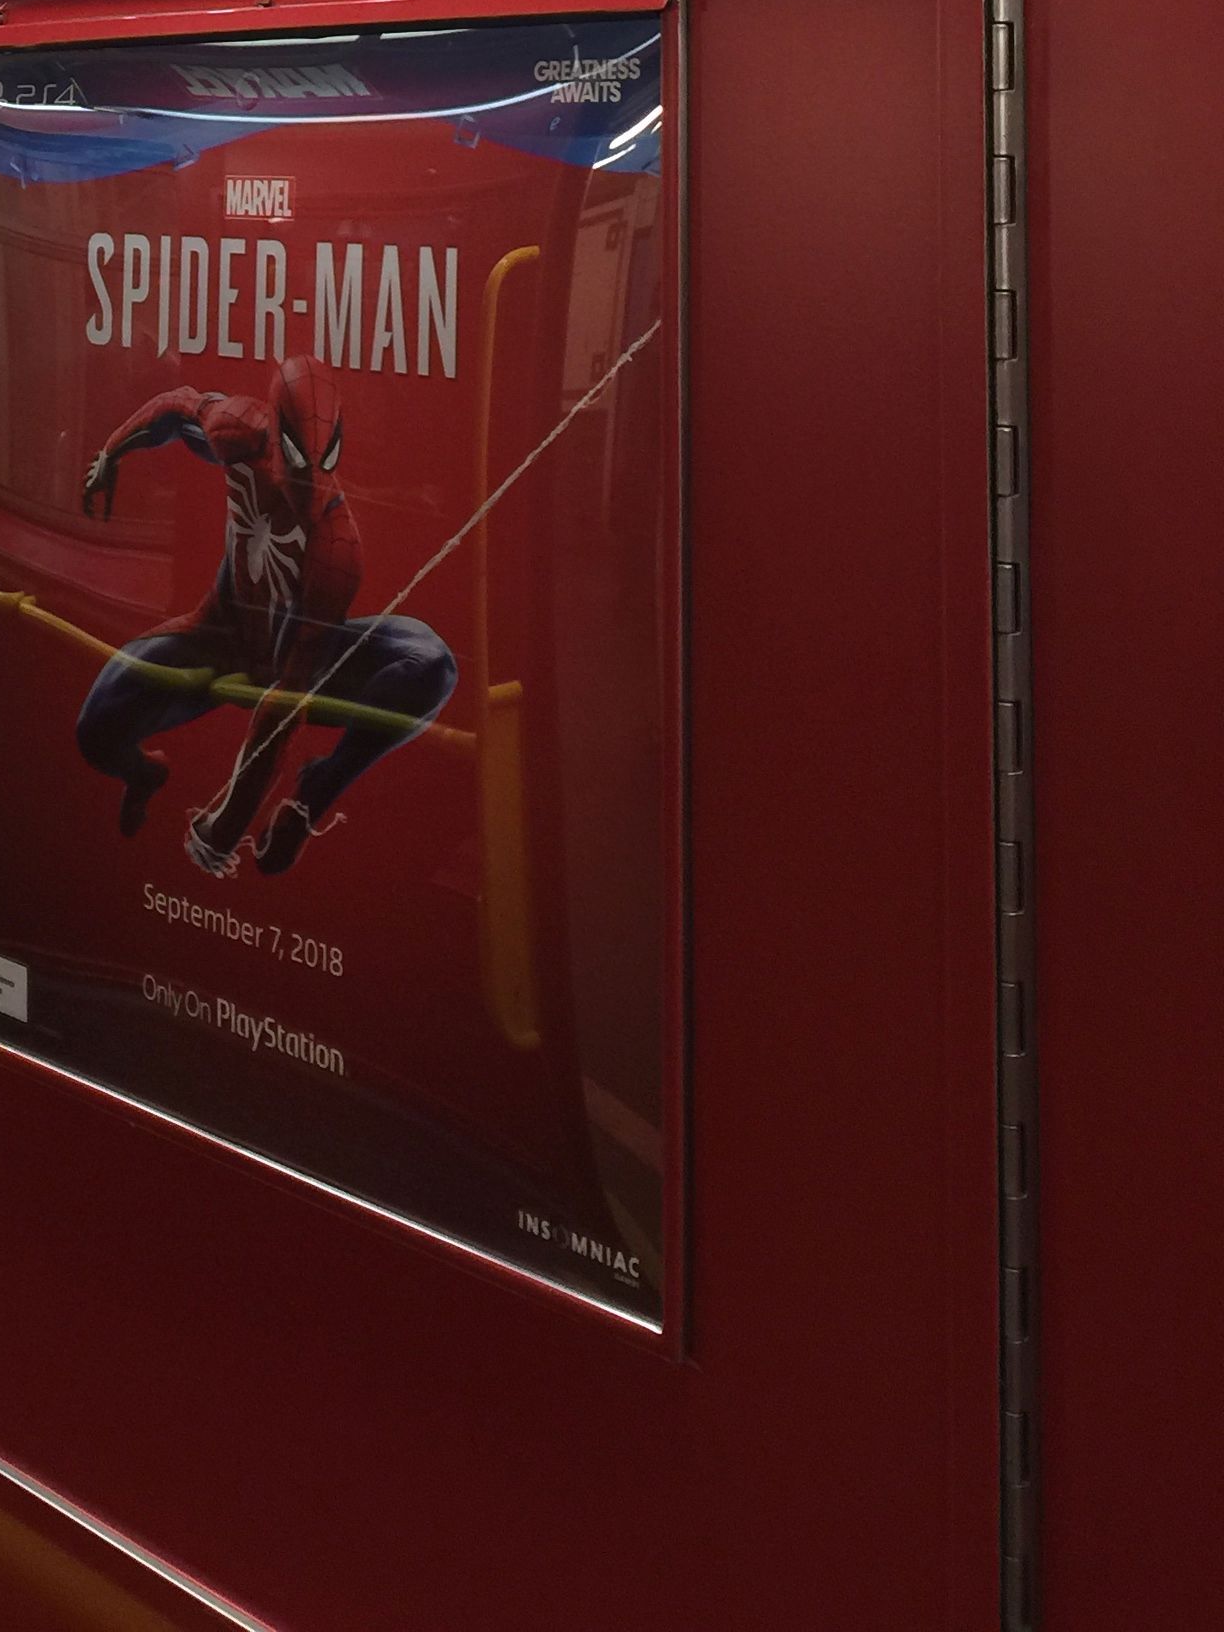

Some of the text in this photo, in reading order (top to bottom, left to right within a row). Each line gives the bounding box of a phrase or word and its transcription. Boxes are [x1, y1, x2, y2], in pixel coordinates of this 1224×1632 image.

[534, 58, 641, 81] GREATNESS
[551, 81, 621, 103] AWAITS
[226, 179, 292, 218] MARVEL
[86, 232, 458, 379] SPIDER-MAN
[143, 883, 343, 977] September 7, 2018
[142, 974, 344, 1076] Only On PlayStation
